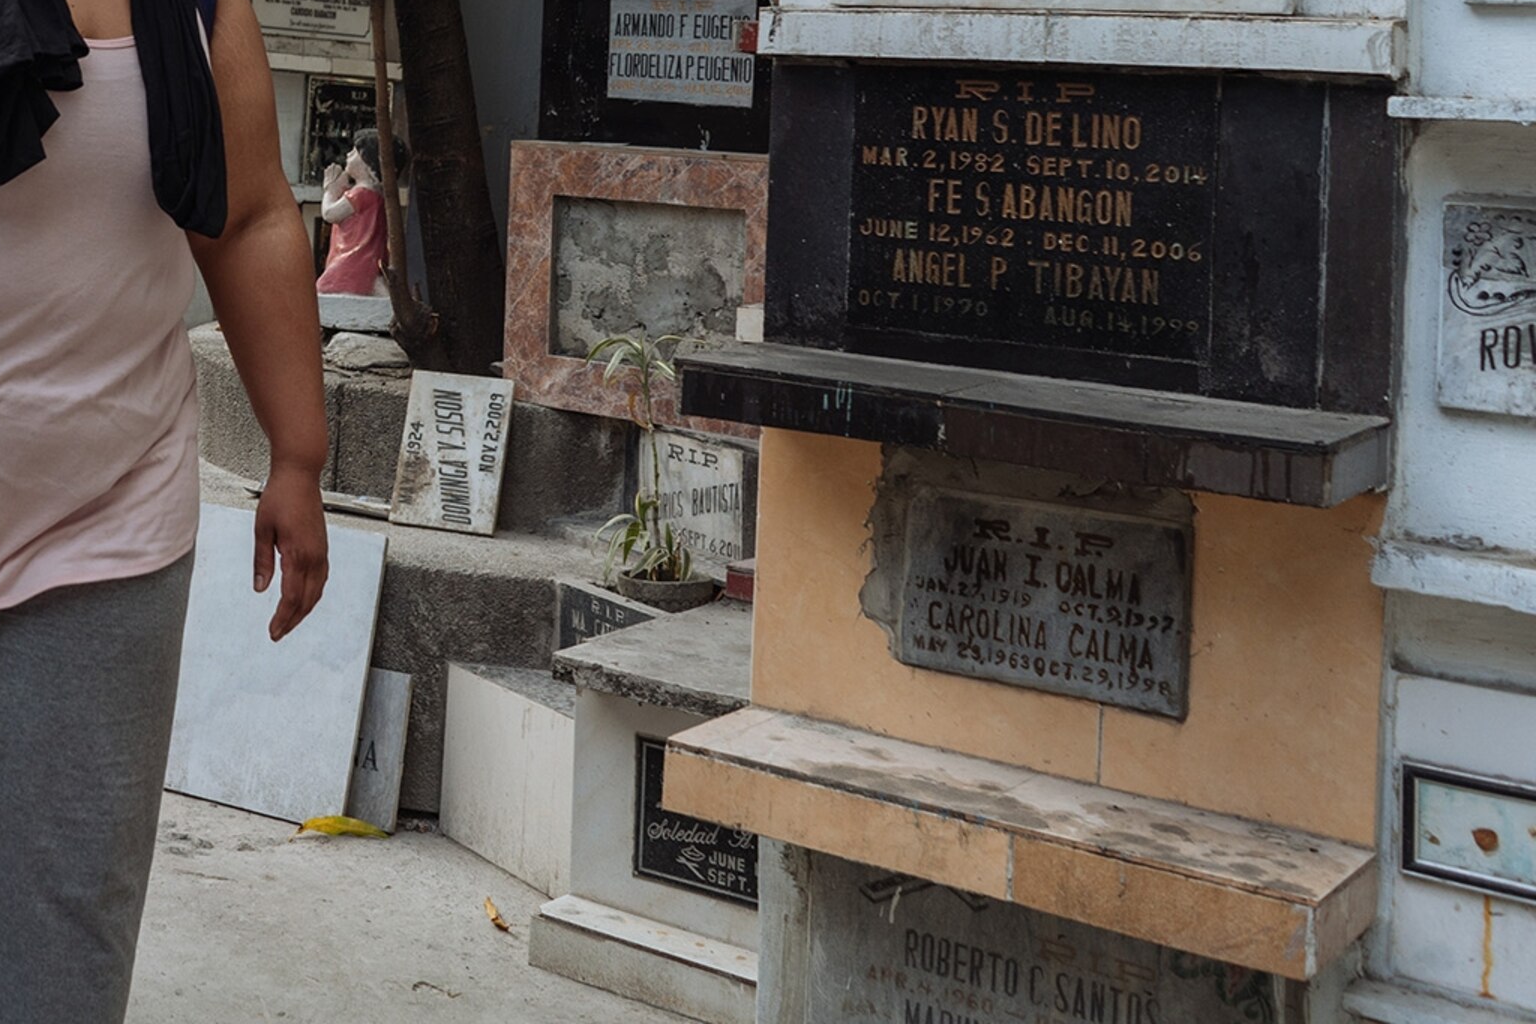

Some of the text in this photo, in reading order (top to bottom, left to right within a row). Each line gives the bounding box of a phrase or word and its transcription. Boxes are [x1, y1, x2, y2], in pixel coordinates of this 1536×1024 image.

[614, 13, 674, 38] ARMANDO
[609, 53, 682, 80] FLORDELIZA
[697, 57, 752, 84] EUGENIO
[911, 105, 978, 144] RYAN
[927, 177, 962, 216] FE
[1001, 183, 1133, 228] ABANGON
[859, 218, 918, 240] JUNE
[892, 248, 972, 288] ANGEL
[1028, 260, 1160, 306] TIBAYAN
[1480, 324, 1536, 371] RO
[433, 388, 465, 437] SISON
[438, 460, 472, 526] DOMINGA
[692, 483, 739, 516] BAUTISTA
[943, 544, 1008, 582] JUAN
[928, 601, 1154, 672] CAROLINA CALMA
[647, 819, 720, 845] Soledad
[708, 868, 751, 892] SEPT.
[709, 851, 745, 873] JUNE
[904, 928, 1019, 997] ROBERTO
